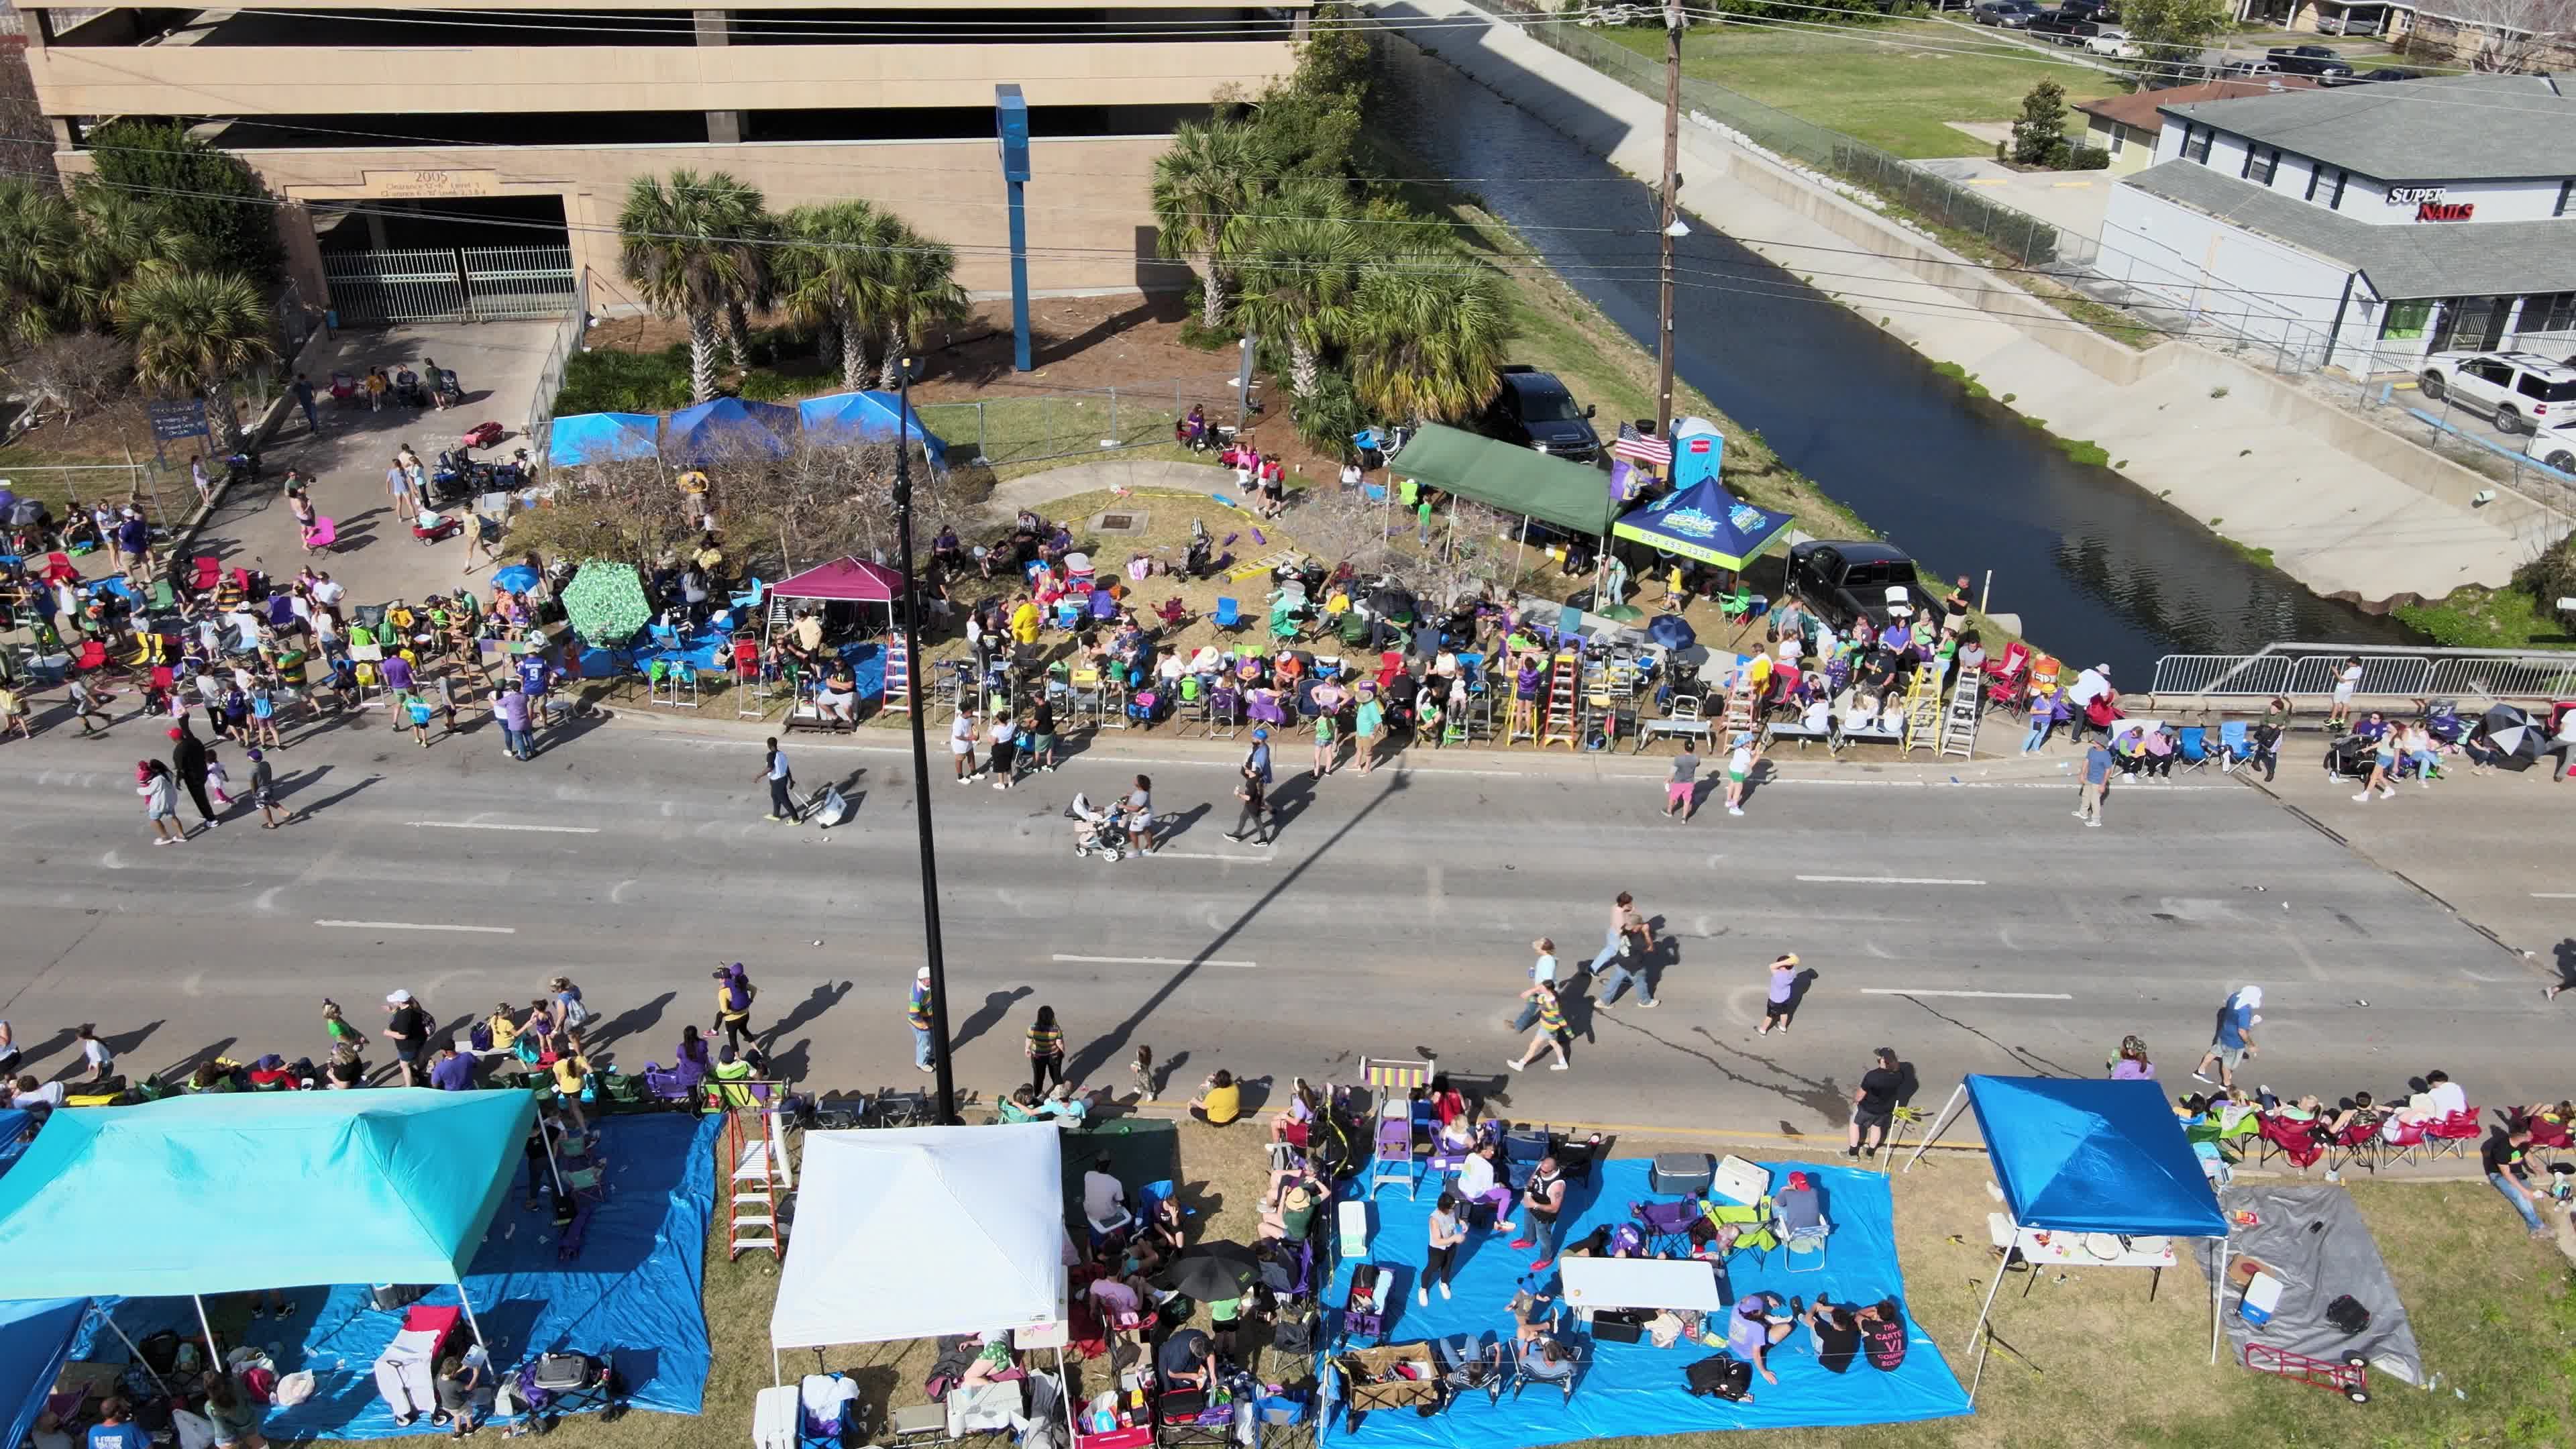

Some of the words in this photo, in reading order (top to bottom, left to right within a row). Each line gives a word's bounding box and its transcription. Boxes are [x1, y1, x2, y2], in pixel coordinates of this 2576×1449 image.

[415, 171, 448, 182] 2005
[2388, 187, 2447, 203] SUPER
[2416, 203, 2474, 221] NAILS
[530, 668, 538, 681] 9
[1885, 1339, 1901, 1352] VI
